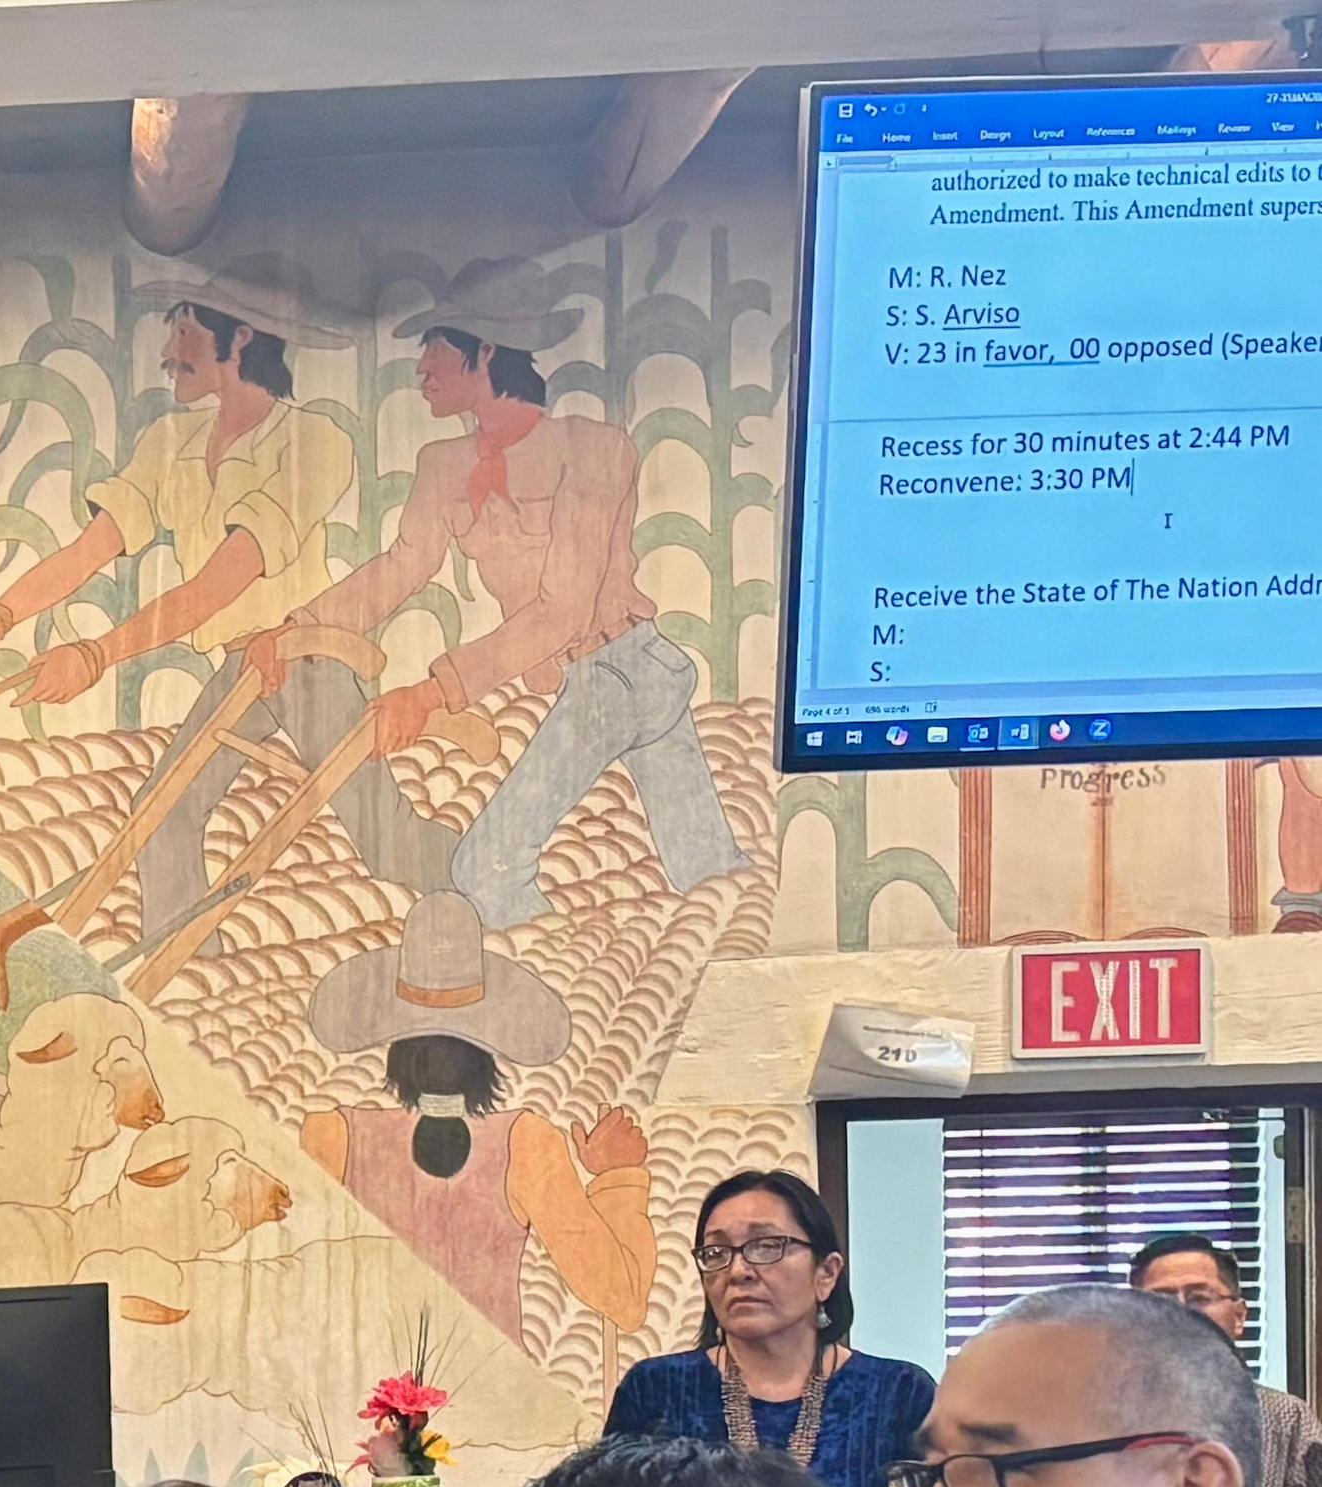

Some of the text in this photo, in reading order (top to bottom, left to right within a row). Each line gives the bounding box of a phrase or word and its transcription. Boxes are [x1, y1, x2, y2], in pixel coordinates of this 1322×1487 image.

[931, 168, 1041, 191] authorized
[1048, 170, 1068, 188] to
[1073, 166, 1130, 188] make
[1137, 162, 1230, 186] technical
[1236, 161, 1285, 184] edits
[1291, 162, 1311, 182] to
[930, 201, 1065, 225] Amendment.
[1073, 199, 1118, 222] This
[1125, 196, 1254, 220] Amendment
[889, 264, 1007, 288] M: R. Nez
[885, 302, 1021, 327] S: S. Arviso
[885, 342, 909, 365] V:
[917, 342, 946, 364] 23
[956, 341, 976, 363] in
[984, 339, 1055, 366] favor,
[1070, 337, 1101, 359] 00
[1107, 332, 1214, 364] opposed
[881, 425, 1290, 458] Recess for 30 minutes at 2:44 PM
[880, 466, 1131, 496] Reconvene: 3:30 PM
[874, 584, 968, 609] Receive
[976, 583, 1016, 605] the
[1022, 582, 1086, 604] State
[1093, 578, 1120, 601] of
[1125, 578, 1170, 600] The
[1178, 576, 1257, 599] Nation
[872, 623, 905, 646] M:
[869, 661, 891, 683] S:
[1040, 764, 1167, 794] Progress
[1051, 957, 1179, 1042] EXIT
